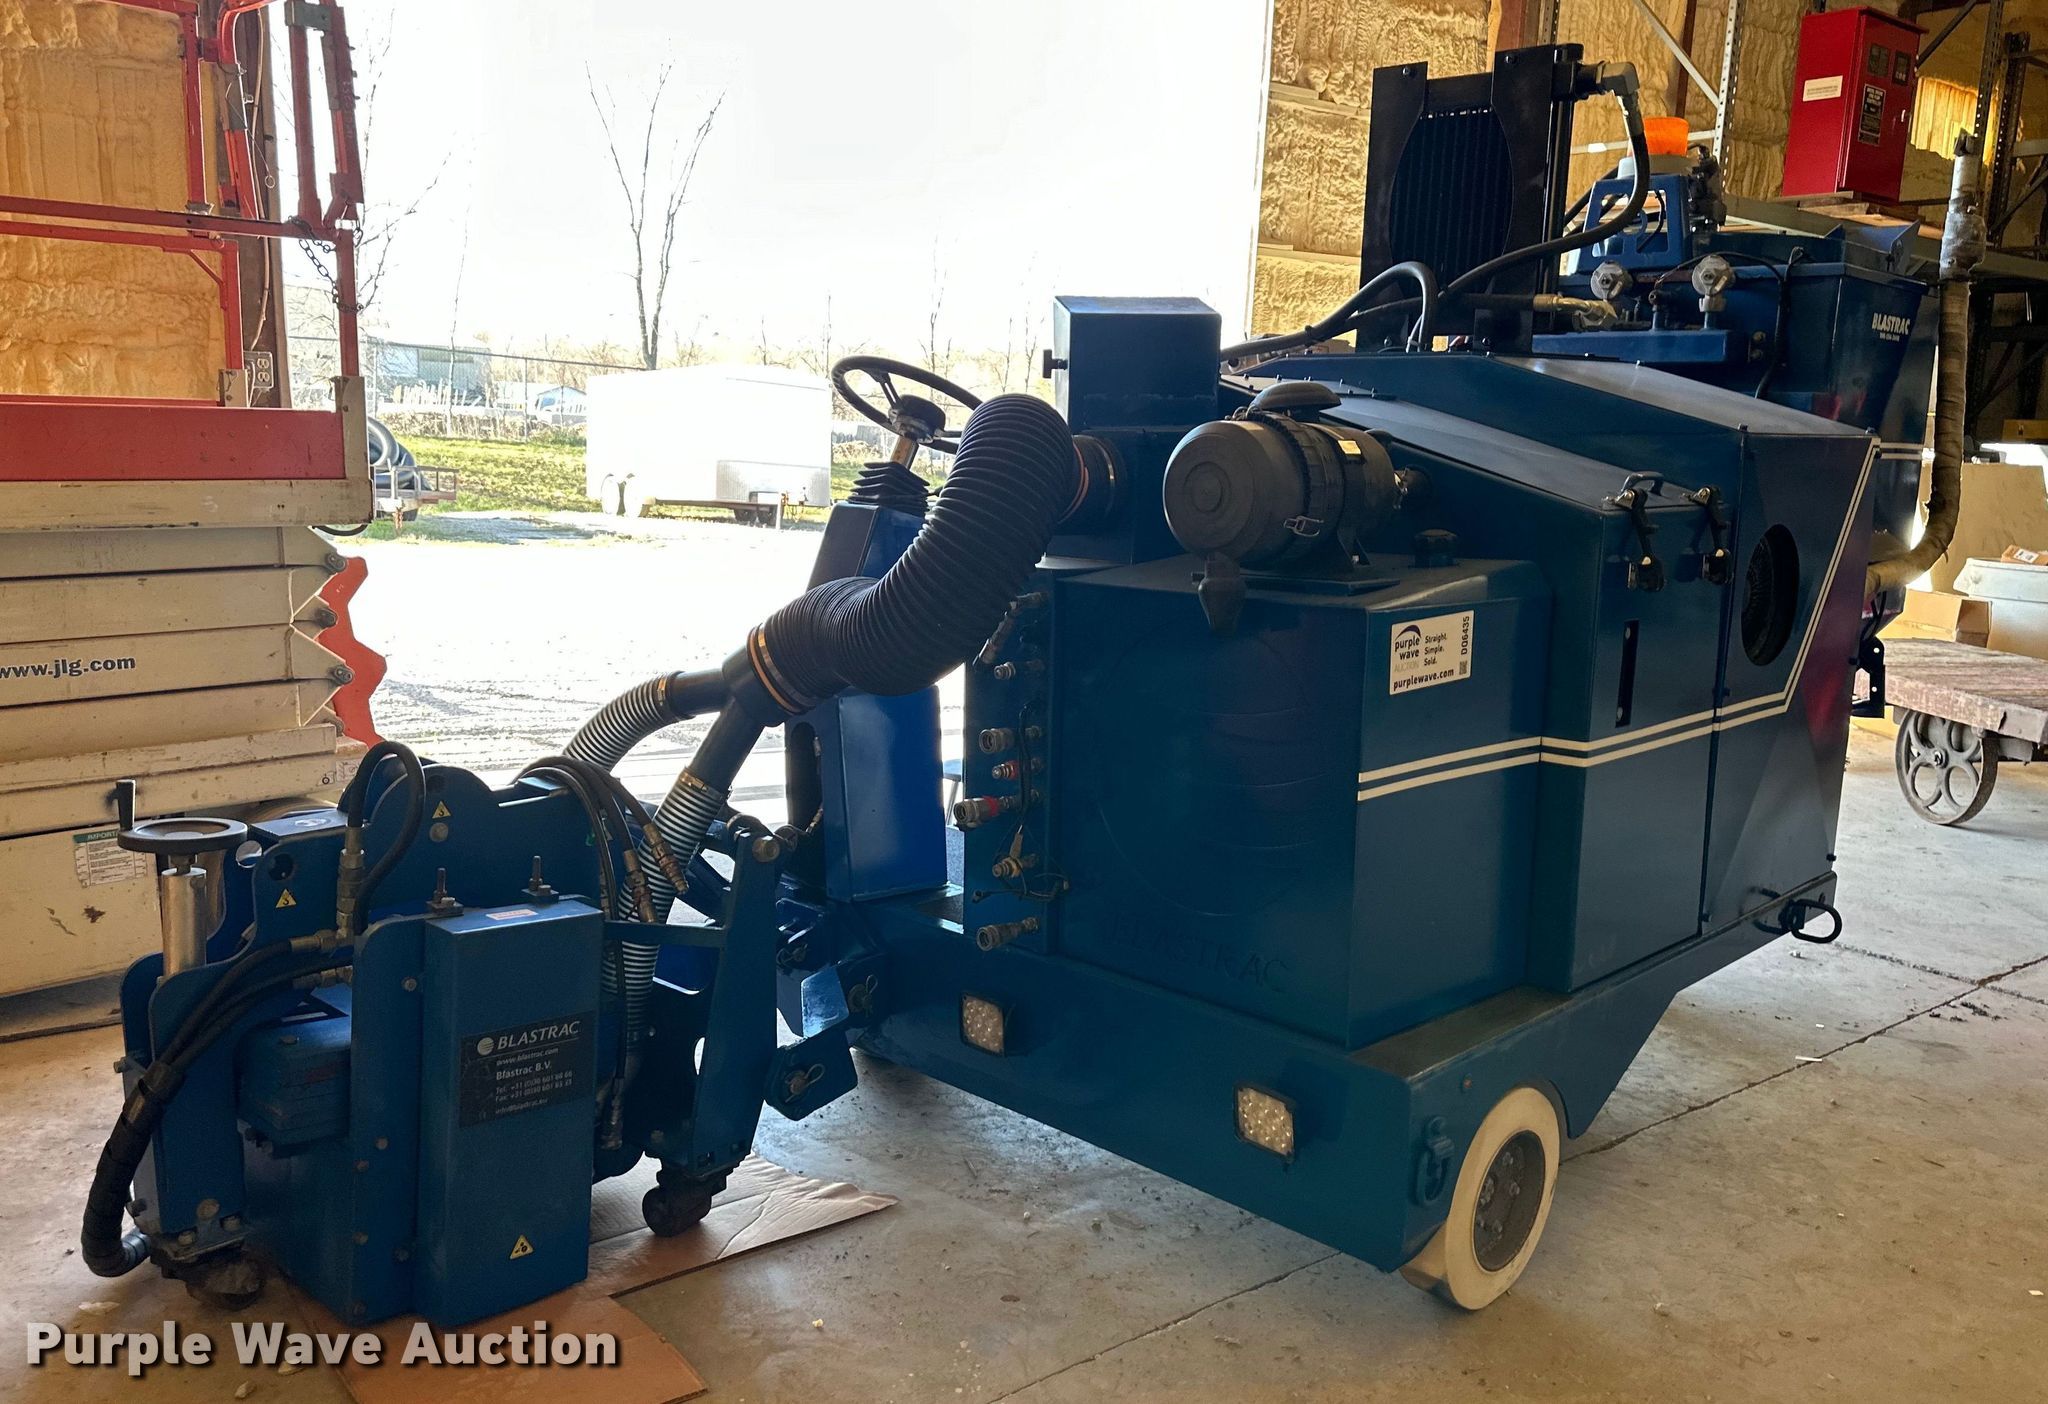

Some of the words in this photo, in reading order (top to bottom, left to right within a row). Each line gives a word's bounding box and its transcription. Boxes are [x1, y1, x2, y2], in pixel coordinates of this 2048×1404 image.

[1871, 312, 1911, 335] BLASTRAC
[1394, 635, 1420, 652] purple
[1399, 649, 1420, 660] wave
[0, 657, 136, 679] www.jlg.com
[1393, 669, 1455, 692] purplewave.com
[497, 1020, 581, 1050] BLASTRAC
[496, 1065, 534, 1081] Blastrac
